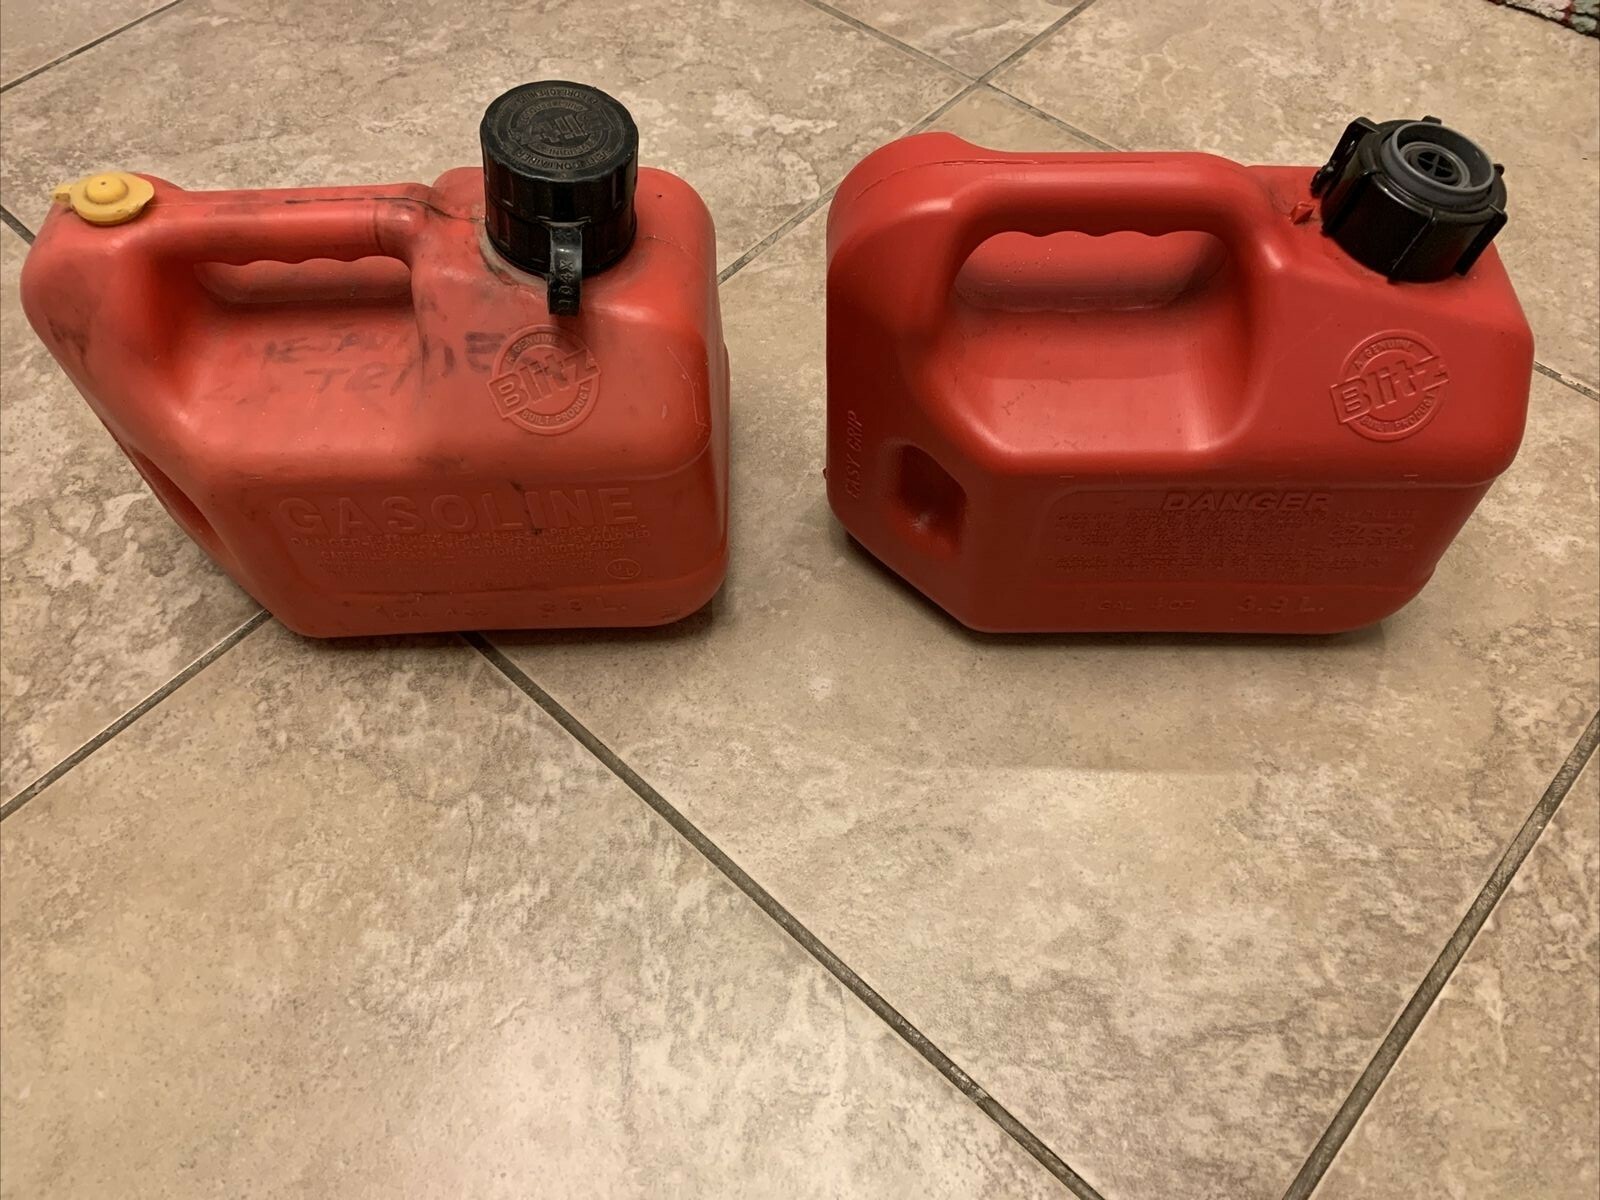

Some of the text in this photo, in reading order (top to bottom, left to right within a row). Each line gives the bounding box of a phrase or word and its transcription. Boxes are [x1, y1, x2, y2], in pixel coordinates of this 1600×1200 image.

[845, 408, 864, 453] GRIP
[278, 487, 638, 536] GASOLINE
[1160, 489, 1331, 511] DANGER
